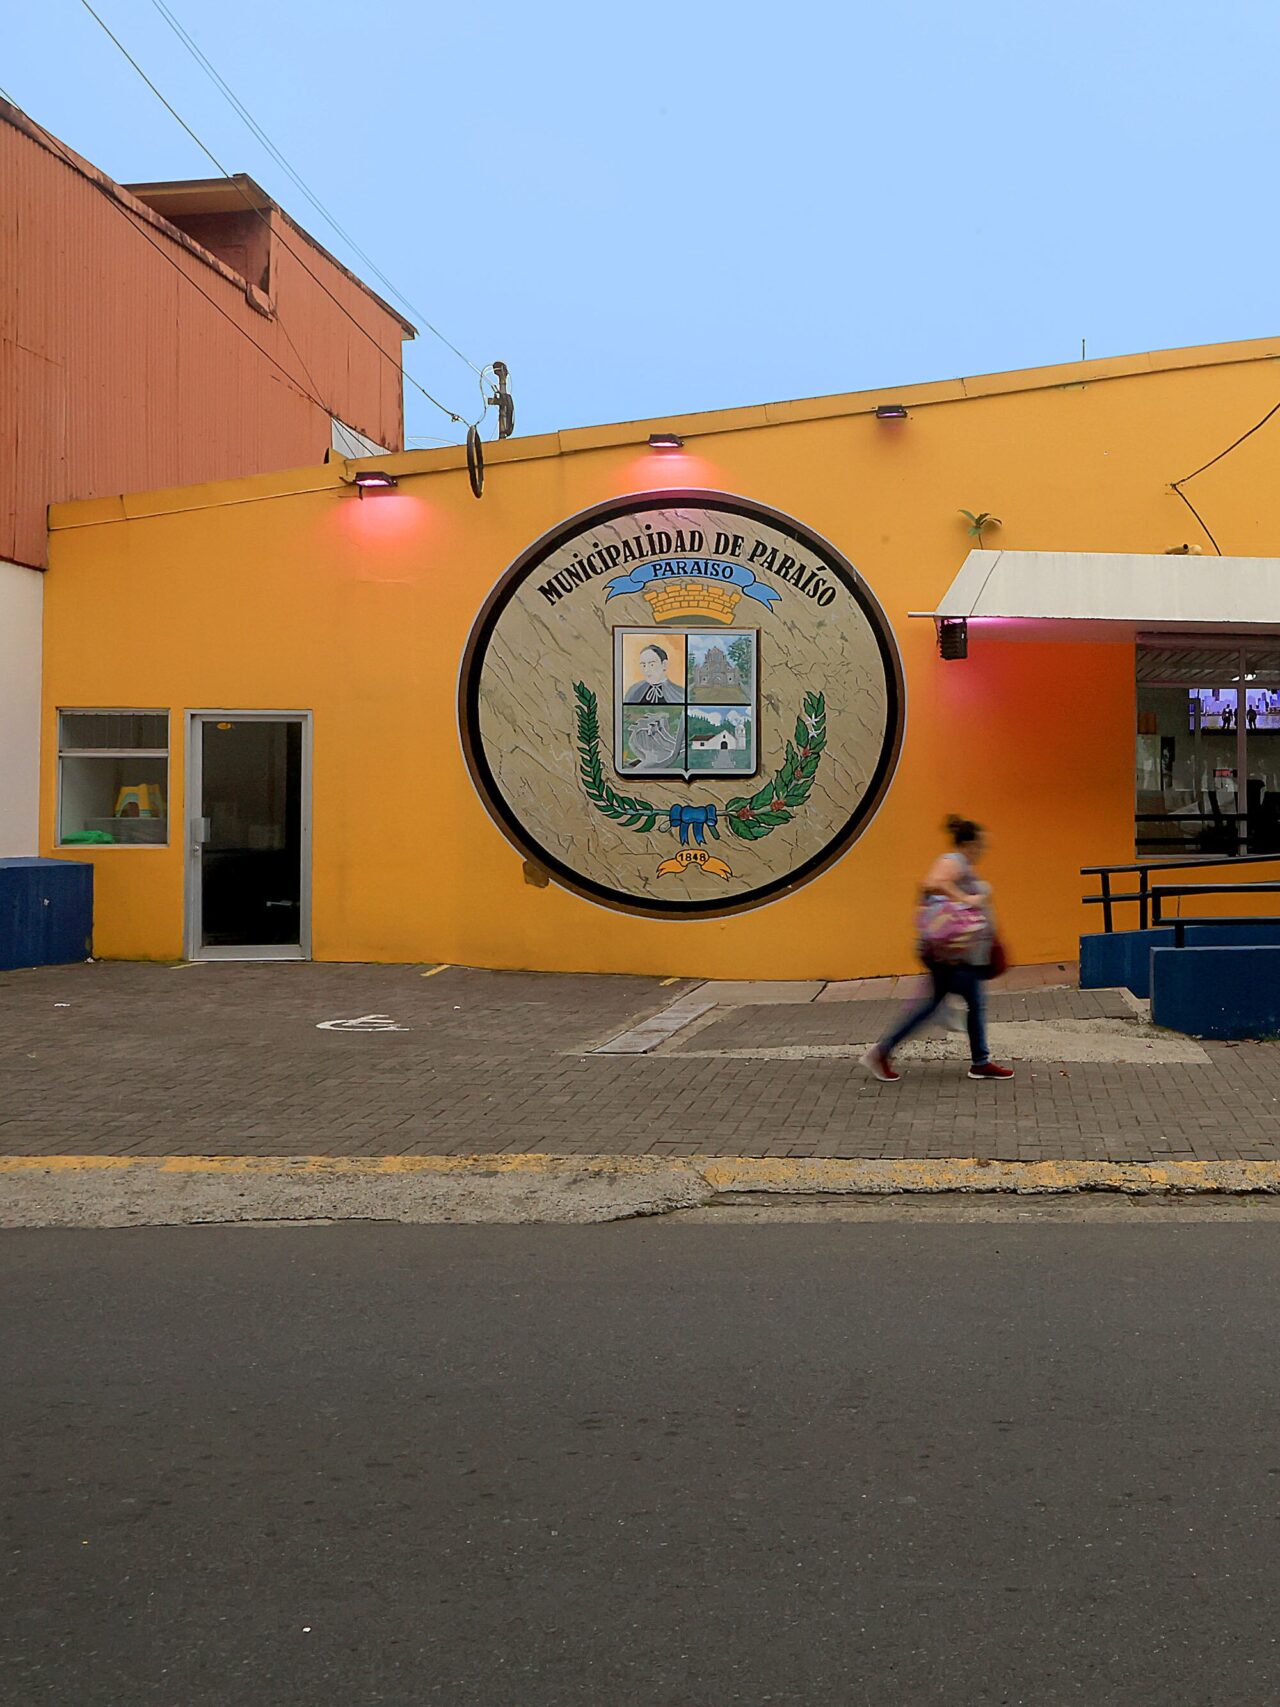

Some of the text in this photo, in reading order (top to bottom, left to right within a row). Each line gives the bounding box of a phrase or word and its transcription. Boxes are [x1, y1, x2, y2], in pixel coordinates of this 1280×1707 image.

[651, 560, 734, 579] PARAÍSO
[713, 532, 745, 557] DE
[747, 539, 837, 607] PARAÍSO
[678, 853, 706, 862] 1848
